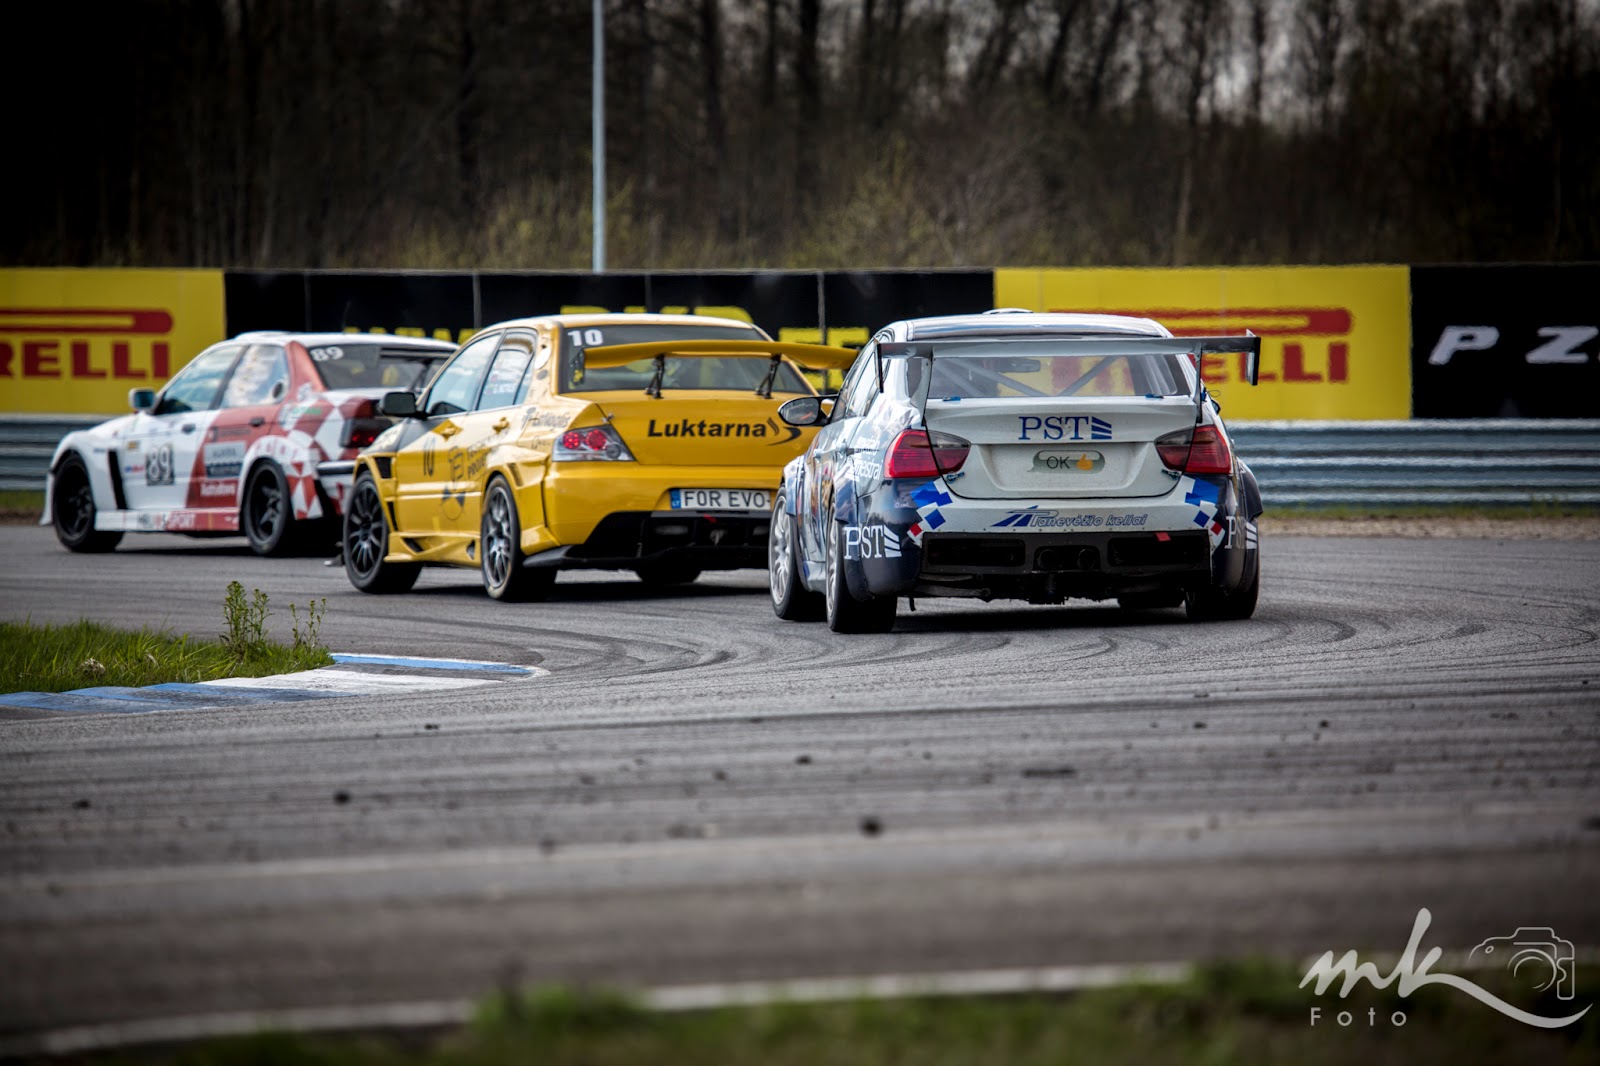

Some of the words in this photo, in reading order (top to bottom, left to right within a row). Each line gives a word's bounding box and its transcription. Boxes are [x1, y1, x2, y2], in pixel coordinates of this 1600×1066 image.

[567, 329, 603, 347] 10
[1525, 325, 1600, 364] Z
[310, 346, 344, 361] 89
[647, 418, 767, 437] Luktarna
[1018, 416, 1089, 440] PST
[149, 443, 172, 480] 89
[423, 436, 436, 477] 10
[1046, 456, 1070, 470] OK
[1105, 514, 1148, 526] keliai
[842, 525, 883, 560] PST
